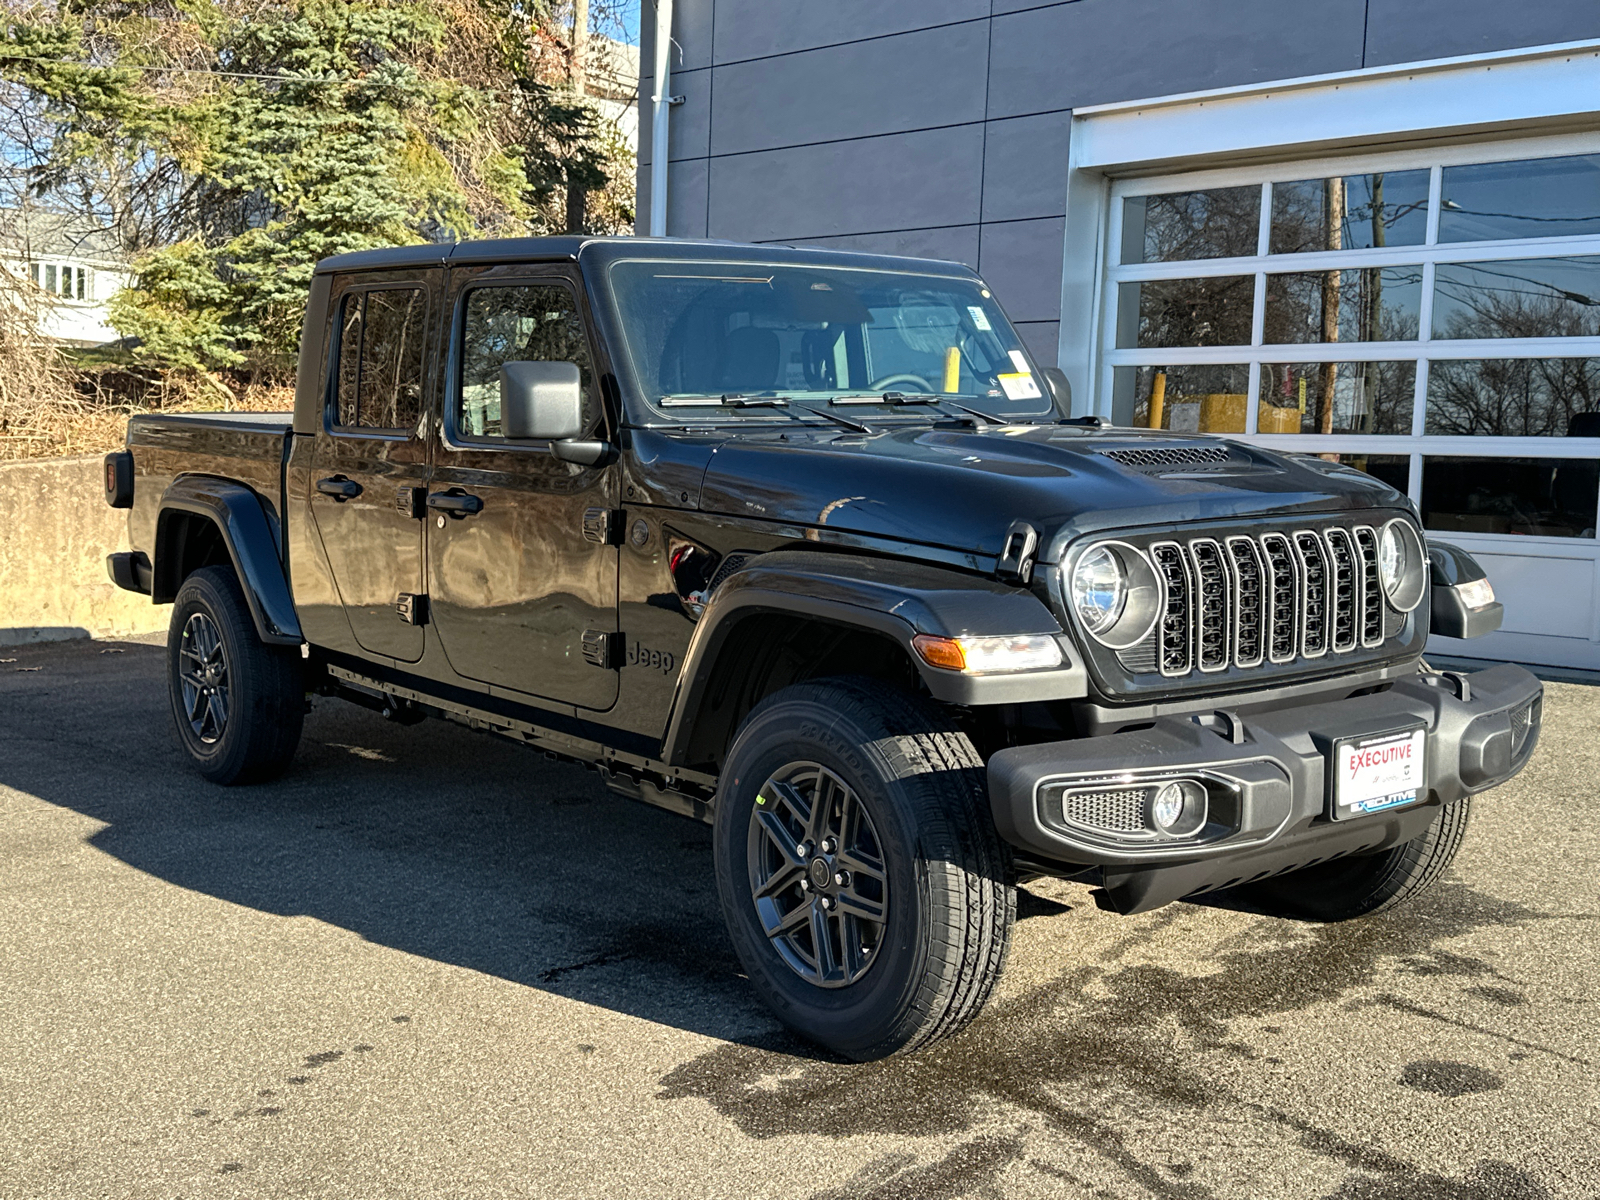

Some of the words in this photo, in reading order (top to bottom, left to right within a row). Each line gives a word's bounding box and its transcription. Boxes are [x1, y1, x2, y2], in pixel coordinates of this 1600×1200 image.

[627, 641, 674, 675] Jeep
[1349, 743, 1412, 780] EXECUTIVE
[1350, 788, 1417, 812] EXECUTIVE
